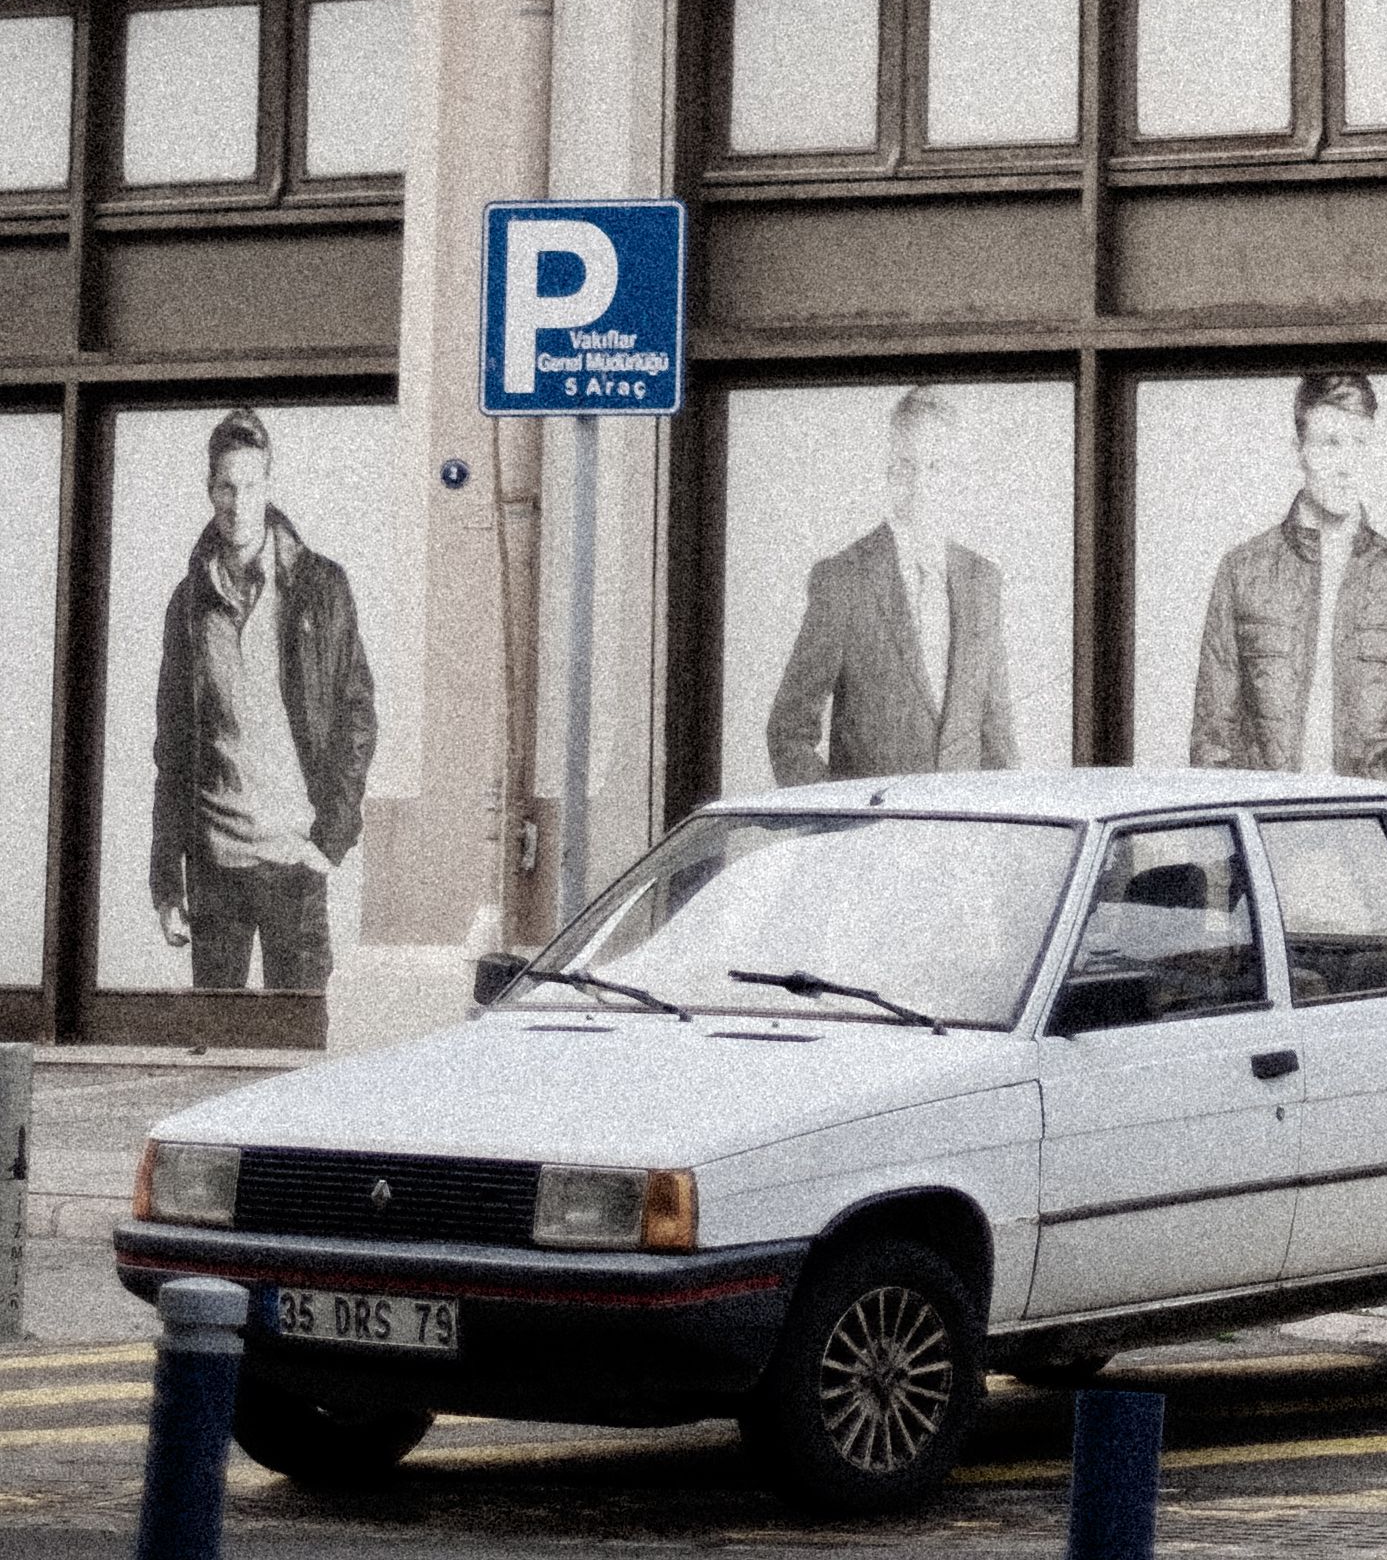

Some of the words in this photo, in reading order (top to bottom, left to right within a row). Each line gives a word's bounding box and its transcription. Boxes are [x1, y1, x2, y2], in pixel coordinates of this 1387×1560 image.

[503, 219, 619, 395] P
[537, 352, 583, 373] Genel
[585, 377, 647, 401] Araç
[280, 1293, 315, 1333] 35
[334, 1296, 393, 1340] DRS
[414, 1303, 453, 1346] 79
